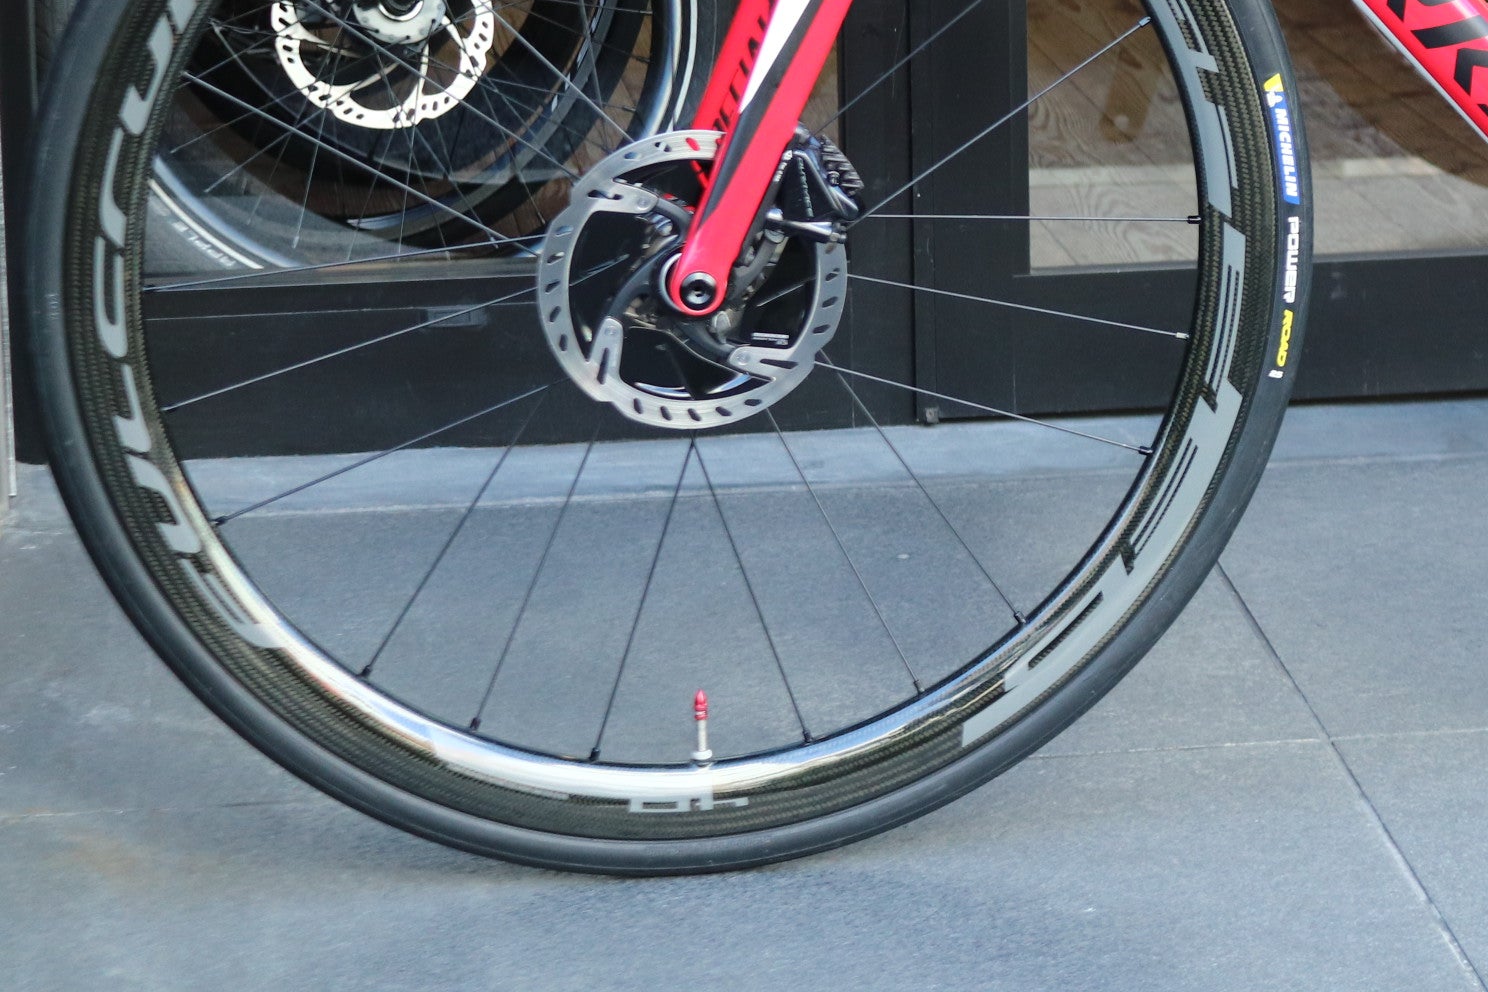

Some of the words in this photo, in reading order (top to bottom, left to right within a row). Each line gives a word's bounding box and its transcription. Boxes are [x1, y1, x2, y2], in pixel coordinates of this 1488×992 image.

[1274, 109, 1298, 197] MICHELIN
[1282, 216, 1300, 304] POWER
[1276, 309, 1294, 368] ROAD
